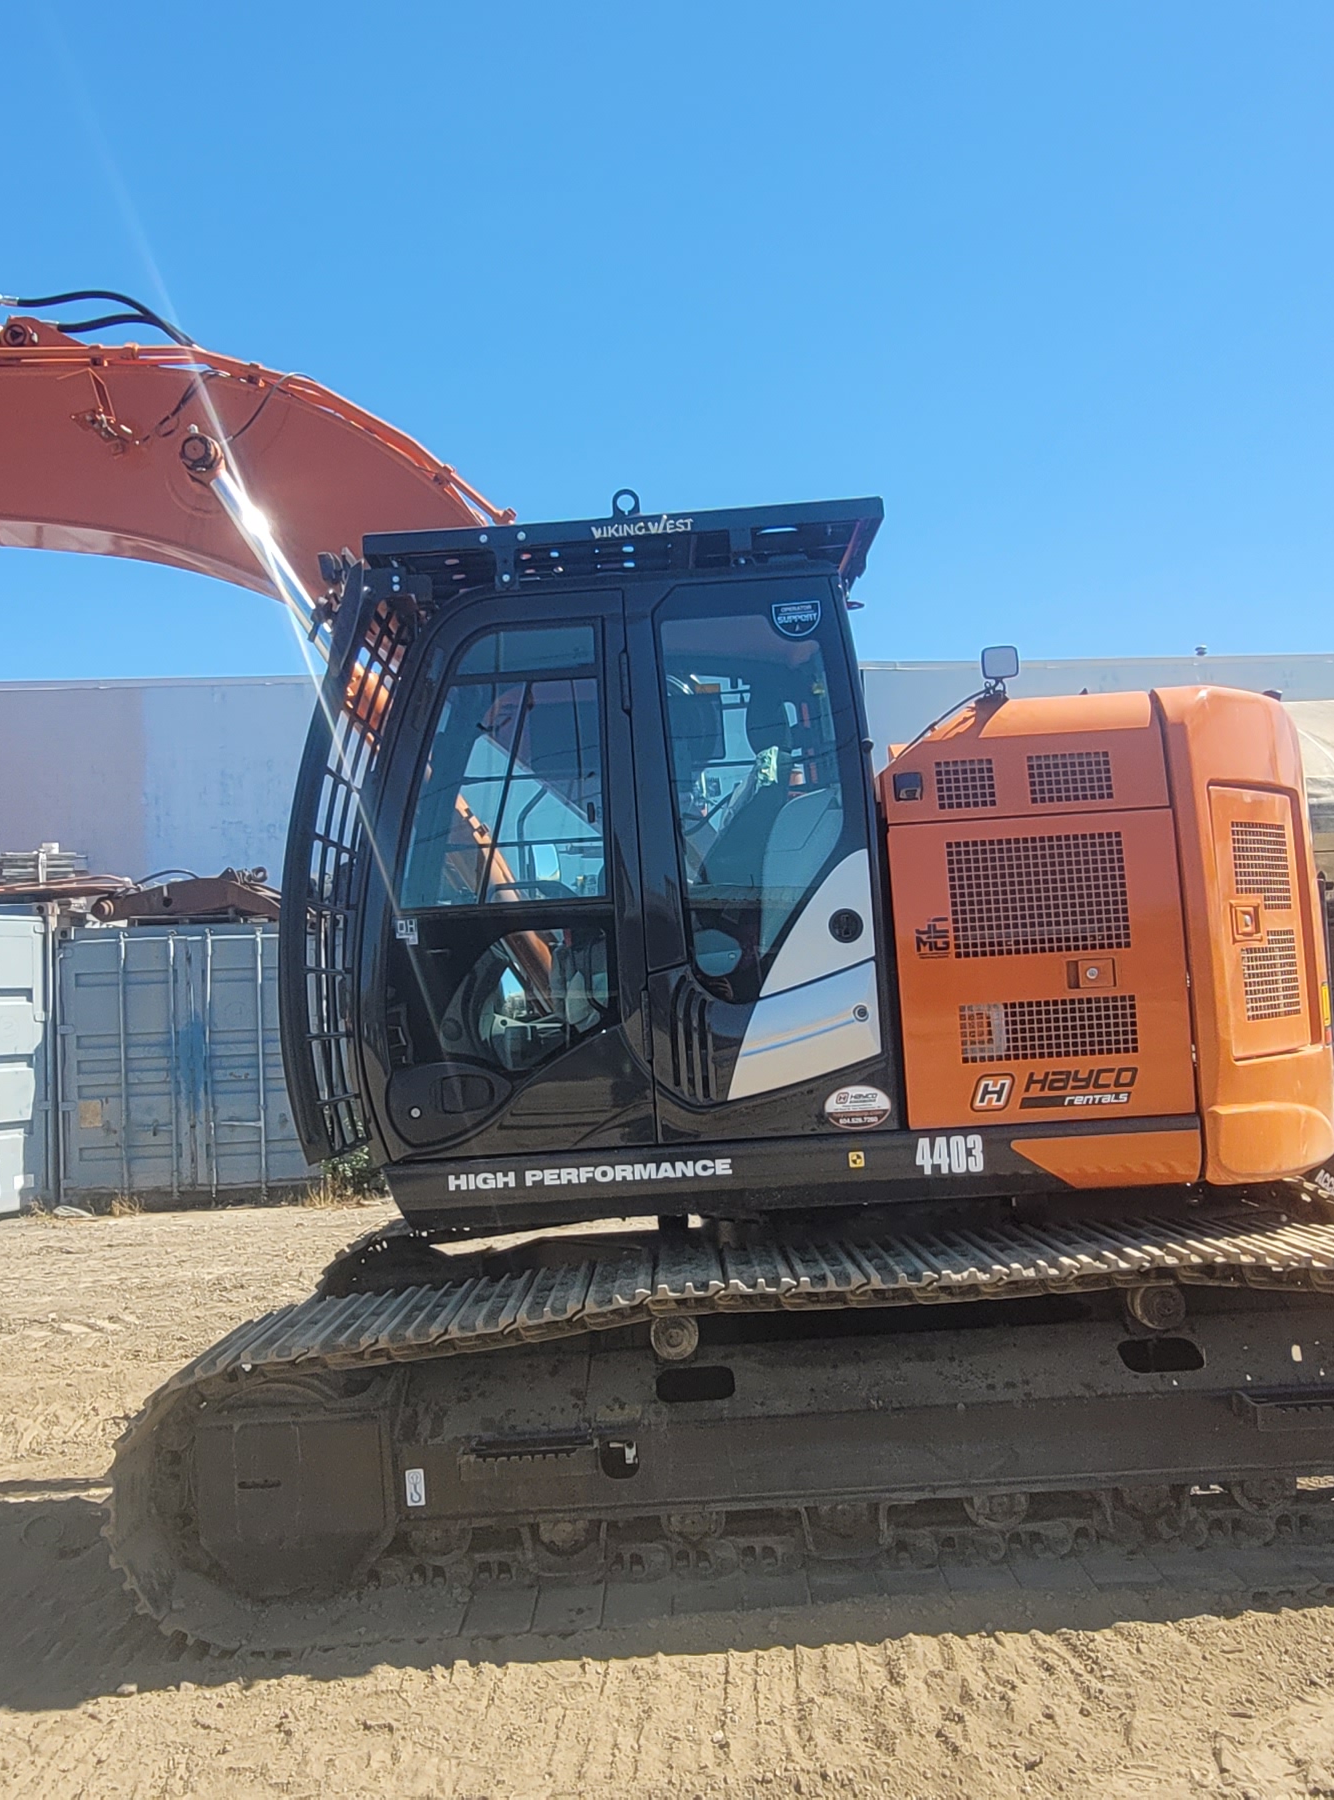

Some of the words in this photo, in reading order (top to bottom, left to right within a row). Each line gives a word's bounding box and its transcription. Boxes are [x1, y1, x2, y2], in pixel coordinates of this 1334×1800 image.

[591, 521, 646, 539] VIKING
[648, 514, 694, 533] WEST
[777, 612, 817, 624] SUPPORT
[915, 1134, 985, 1175] 4403
[447, 1170, 516, 1191] HIGH
[524, 1158, 733, 1186] PERFORMANCE
